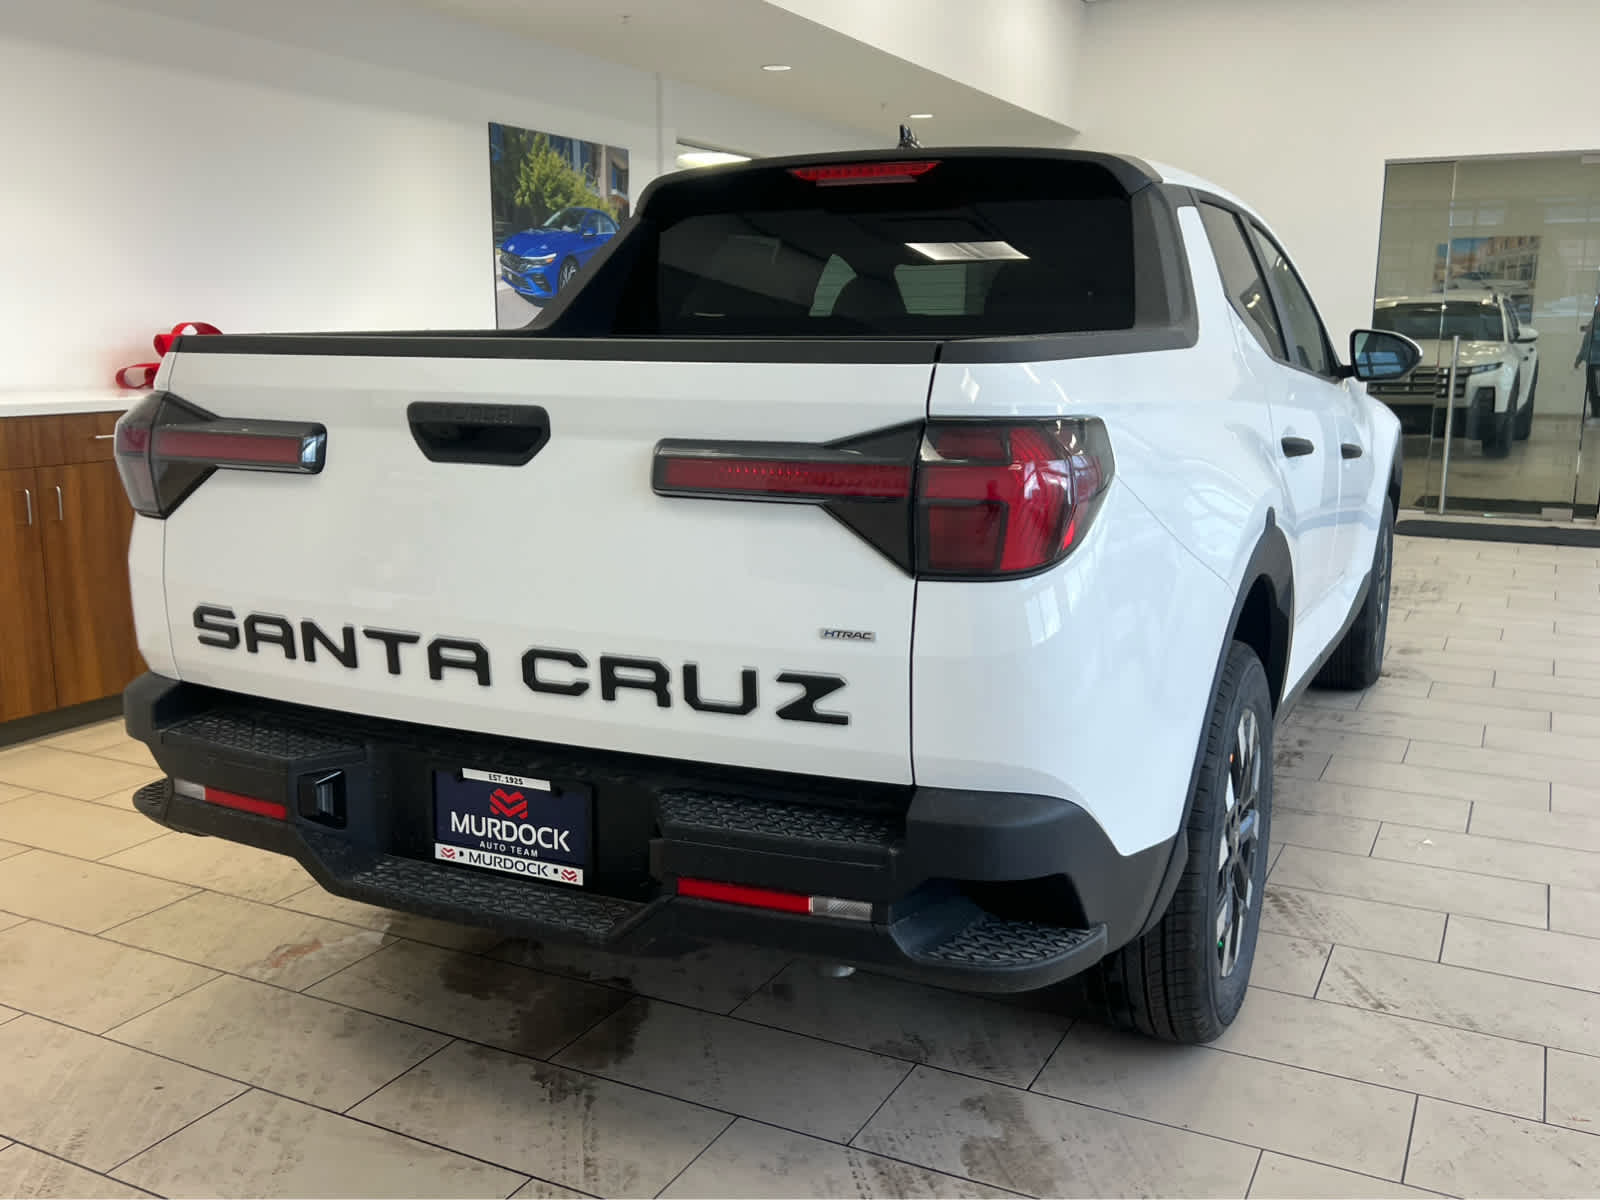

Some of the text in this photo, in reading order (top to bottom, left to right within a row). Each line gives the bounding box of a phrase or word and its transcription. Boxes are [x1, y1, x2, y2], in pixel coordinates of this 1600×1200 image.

[823, 628, 873, 641] HTRAC
[193, 604, 850, 726] SANTA CRUZ
[488, 773, 523, 786] EST. 1925
[451, 811, 570, 852] MURDOCK
[479, 840, 538, 858] AUTO TEAM
[468, 852, 548, 877] MURDOCK
